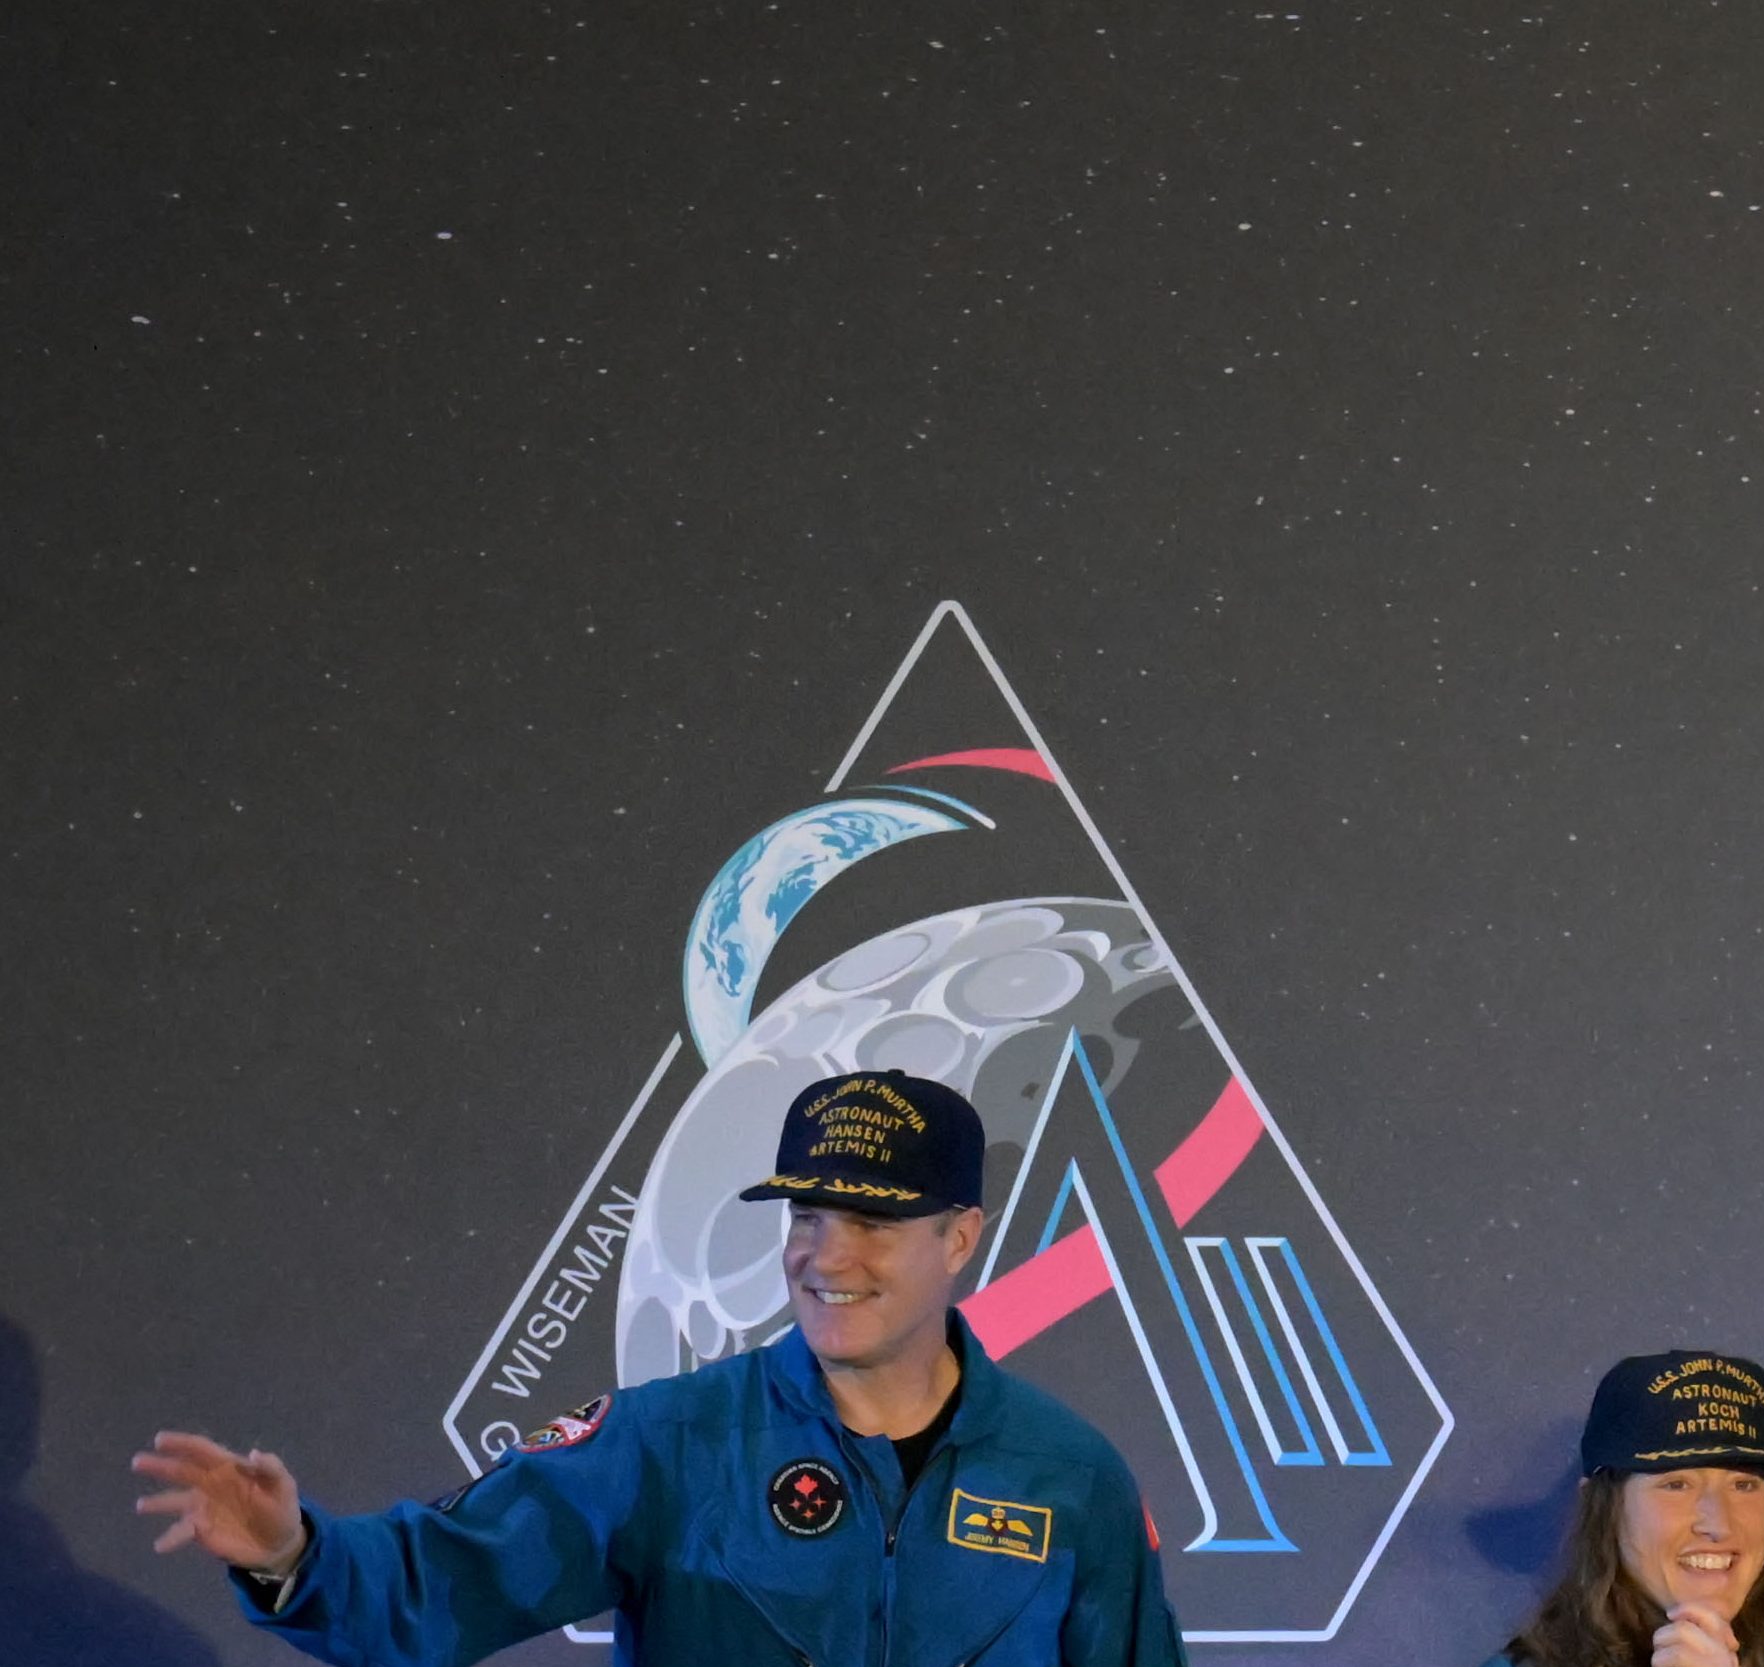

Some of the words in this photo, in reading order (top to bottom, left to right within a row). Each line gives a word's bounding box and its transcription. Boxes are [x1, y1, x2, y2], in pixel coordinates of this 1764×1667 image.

[832, 1079, 863, 1099] JOHN
[877, 1084, 928, 1134] MURTHA
[818, 1106, 904, 1131] ASTRONAUT
[823, 1124, 886, 1144] HANSEN
[809, 1140, 877, 1159] ARTEMIS
[879, 1149, 892, 1163] II
[491, 1185, 639, 1398] WISEMAN
[1679, 1358, 1713, 1377] JOHN
[1672, 1384, 1757, 1407] ASTRONAUT
[1697, 1401, 1740, 1419] KOCH
[1674, 1418, 1746, 1436] ARTEMIS
[1748, 1425, 1757, 1440] II
